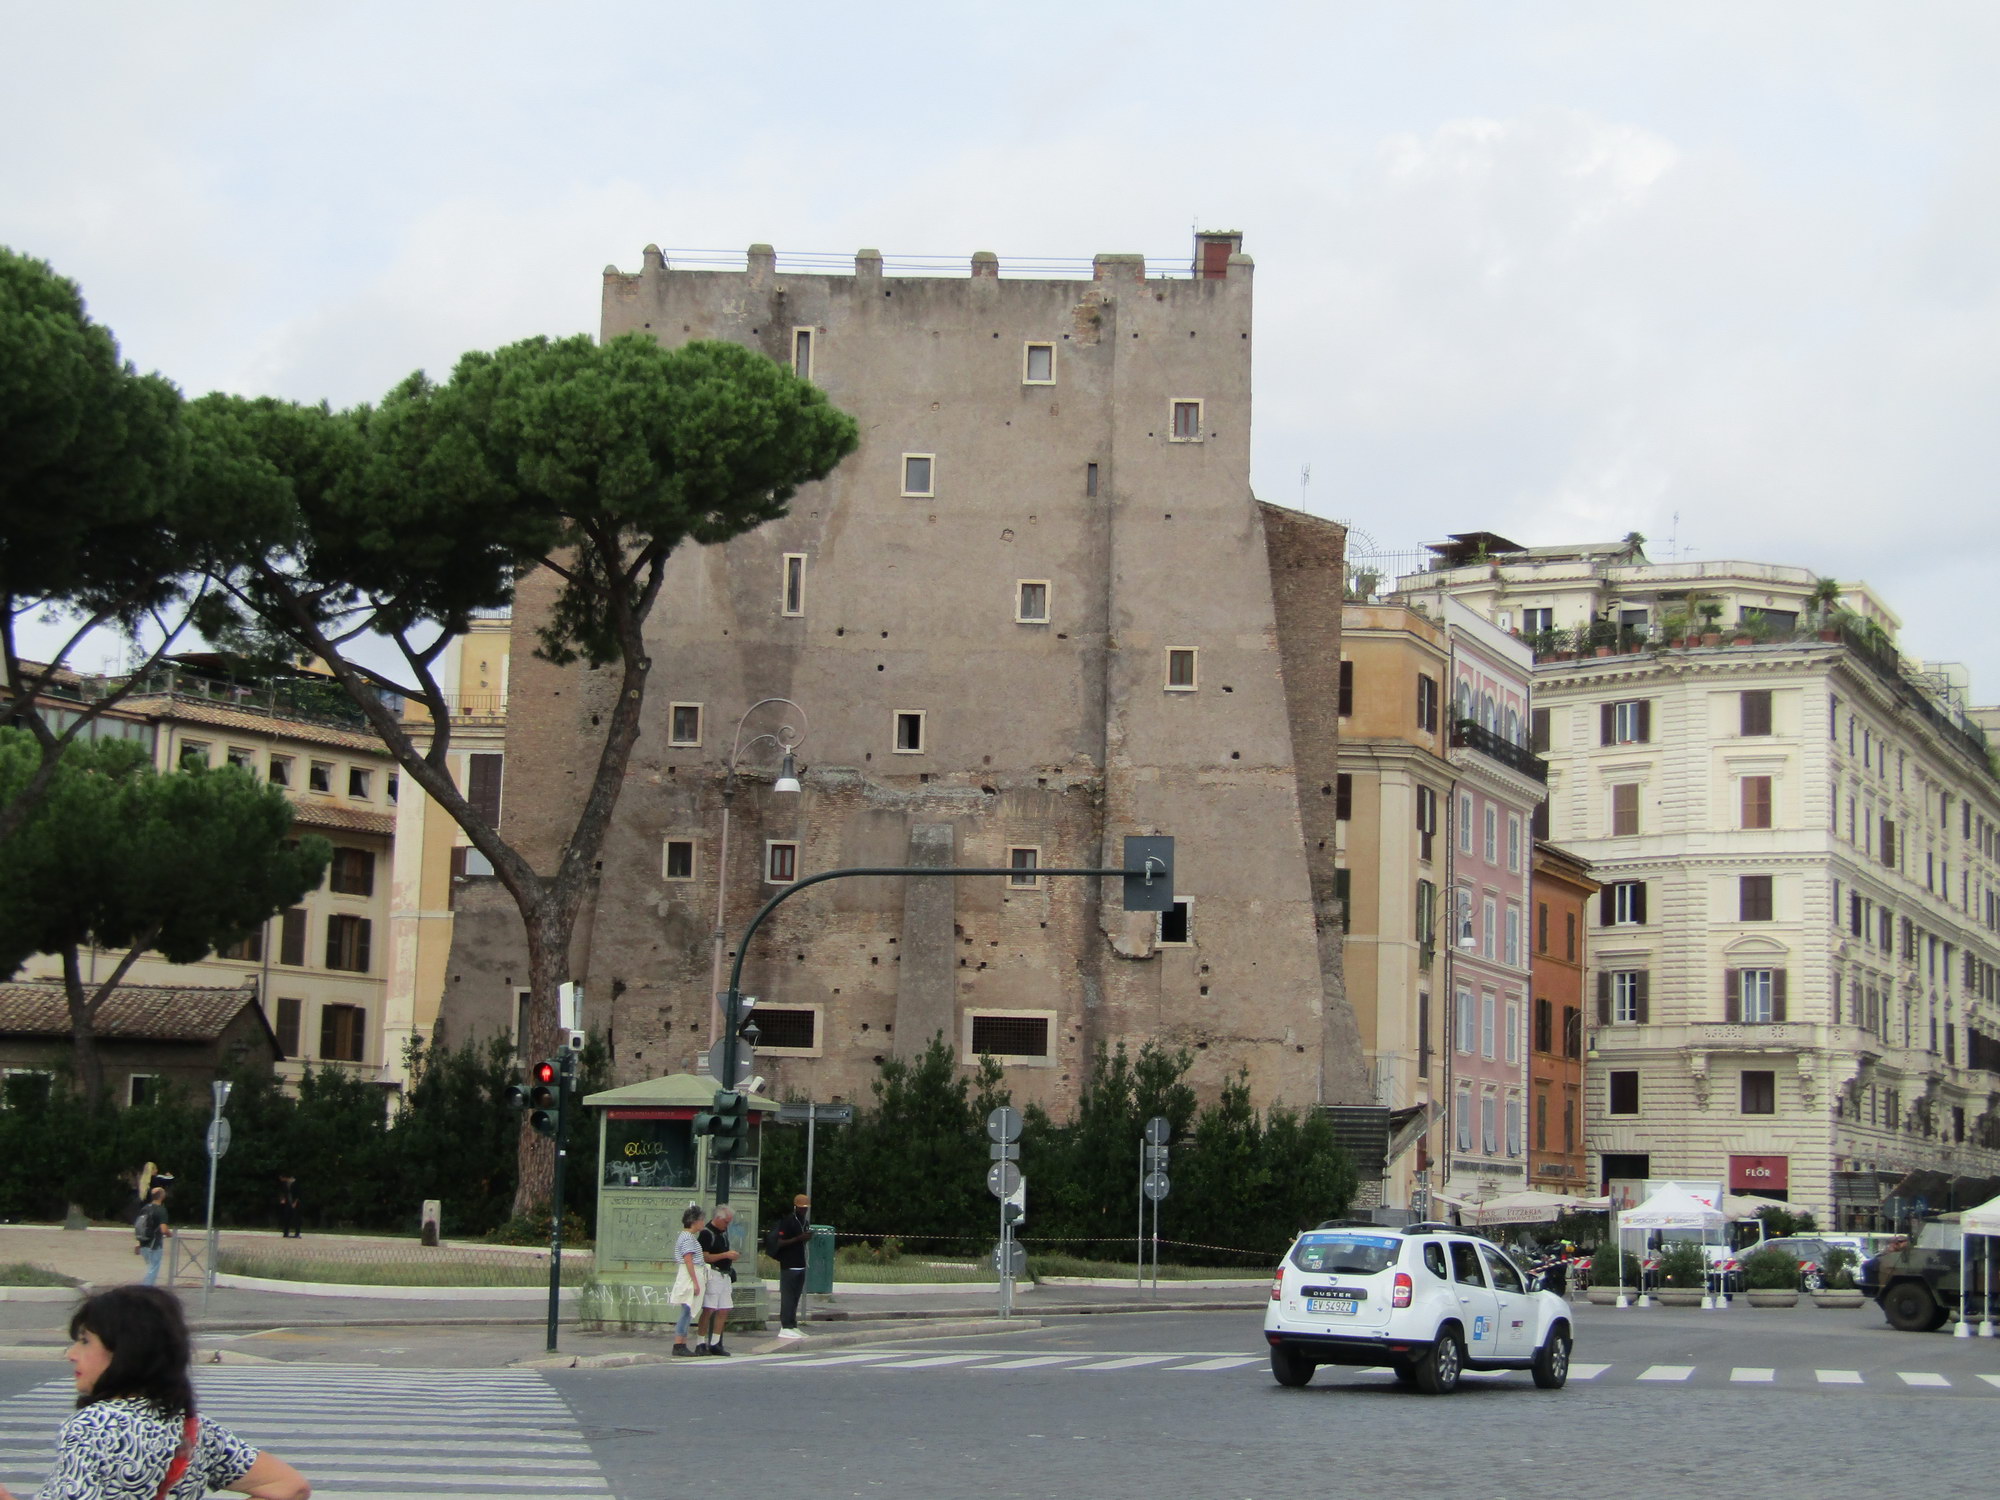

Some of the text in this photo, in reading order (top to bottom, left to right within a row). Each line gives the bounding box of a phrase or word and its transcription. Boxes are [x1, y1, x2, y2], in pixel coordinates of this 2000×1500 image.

[1507, 1208, 1542, 1216] PIZZERIA
[1313, 1300, 1352, 1312] EV 549ZZ
